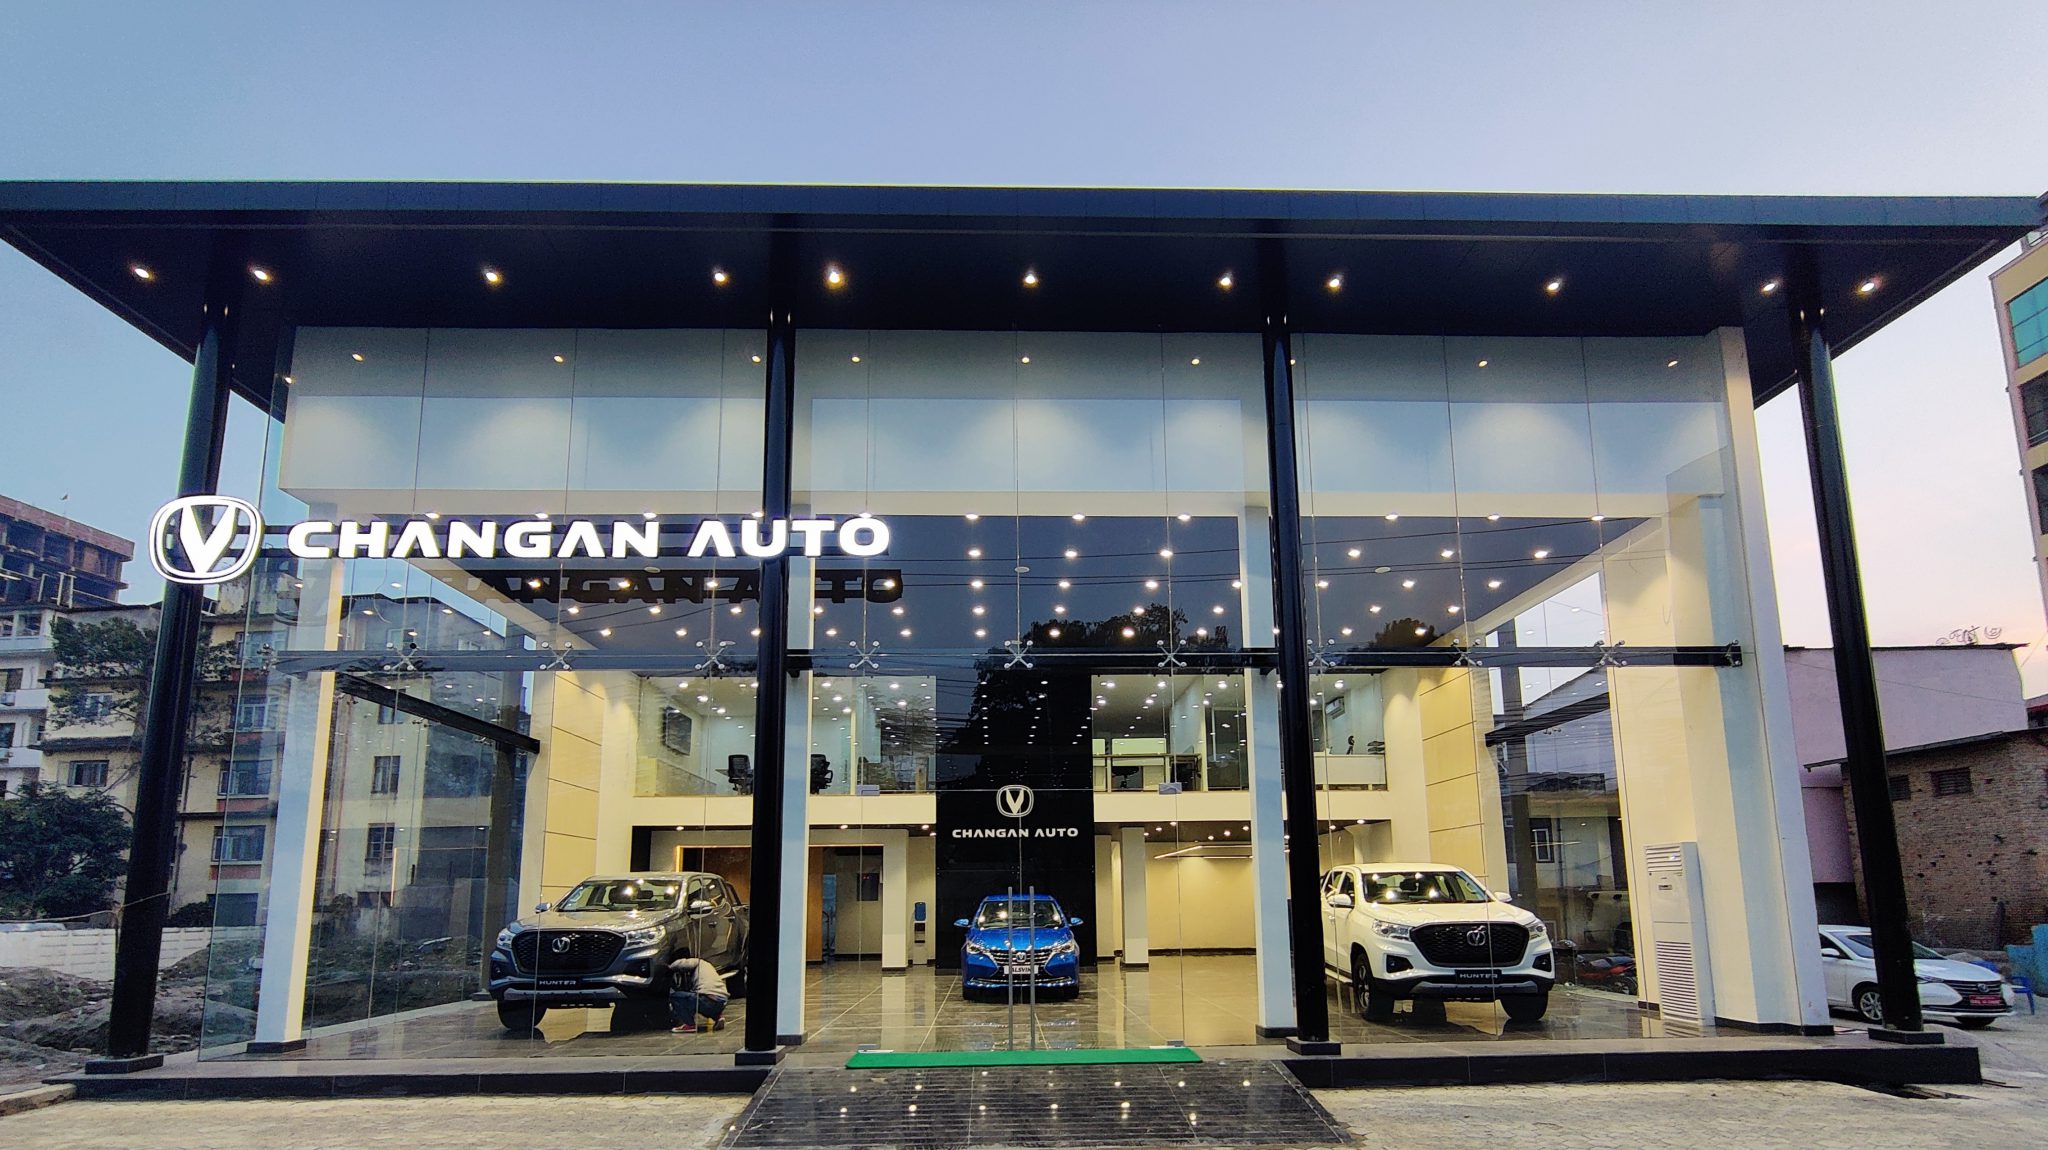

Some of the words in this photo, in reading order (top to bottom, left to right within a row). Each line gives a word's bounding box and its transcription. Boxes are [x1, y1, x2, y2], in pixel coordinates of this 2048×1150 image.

[287, 519, 660, 558] CHANGAN
[687, 517, 891, 557] AUTO
[951, 828, 1029, 838] CHANGAN
[1034, 827, 1079, 838] AUTO
